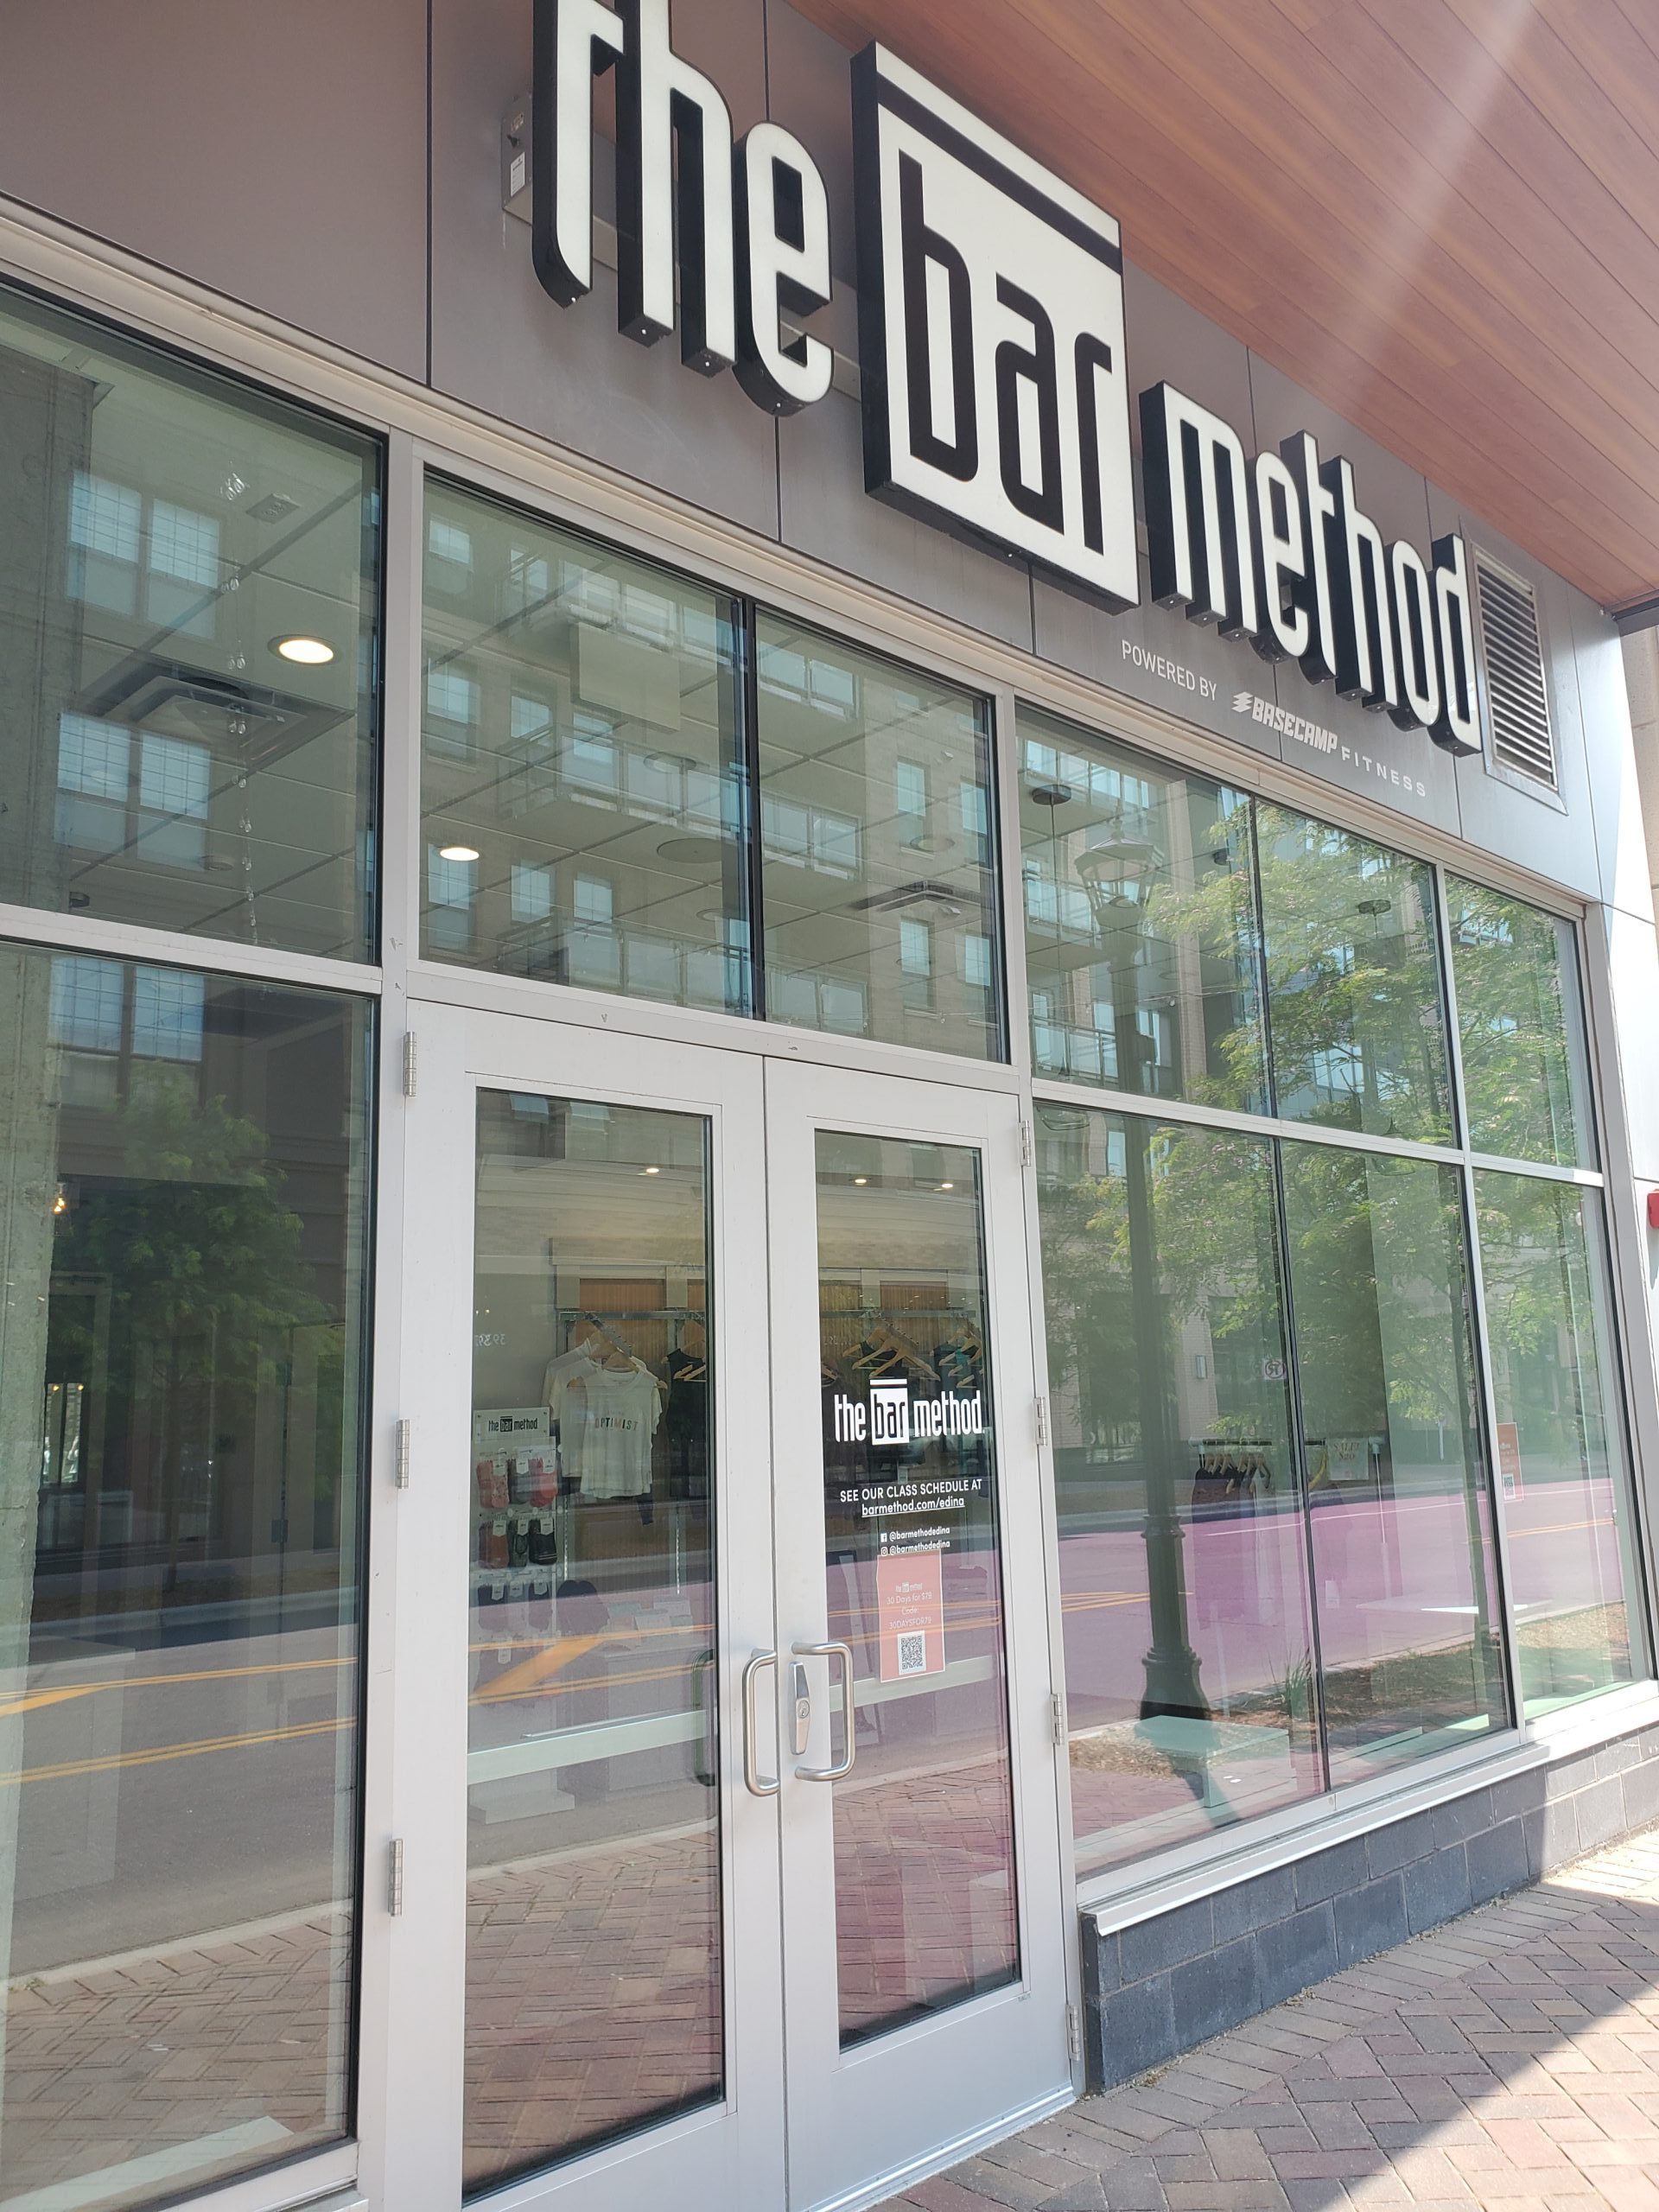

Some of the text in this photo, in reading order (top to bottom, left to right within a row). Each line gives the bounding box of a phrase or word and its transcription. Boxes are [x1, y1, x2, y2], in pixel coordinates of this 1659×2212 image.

[897, 147, 1114, 557] bar
[1139, 380, 1483, 757] method
[1122, 639, 1217, 702] POWERED BY
[1252, 696, 1426, 798] BASECAMP FITNESS
[488, 1420, 499, 1432] the
[514, 1417, 538, 1431] method
[594, 1417, 639, 1432] OPTIMIST
[834, 1394, 867, 1442] the
[873, 1392, 906, 1440] bar
[840, 1478, 982, 1503] SEE OUR CLASS SCHEDULE AT
[861, 1496, 965, 1516] barmethod.com/edina
[889, 1526, 950, 1541] @barmethodedina
[889, 1540, 950, 1555] @barmethodedina
